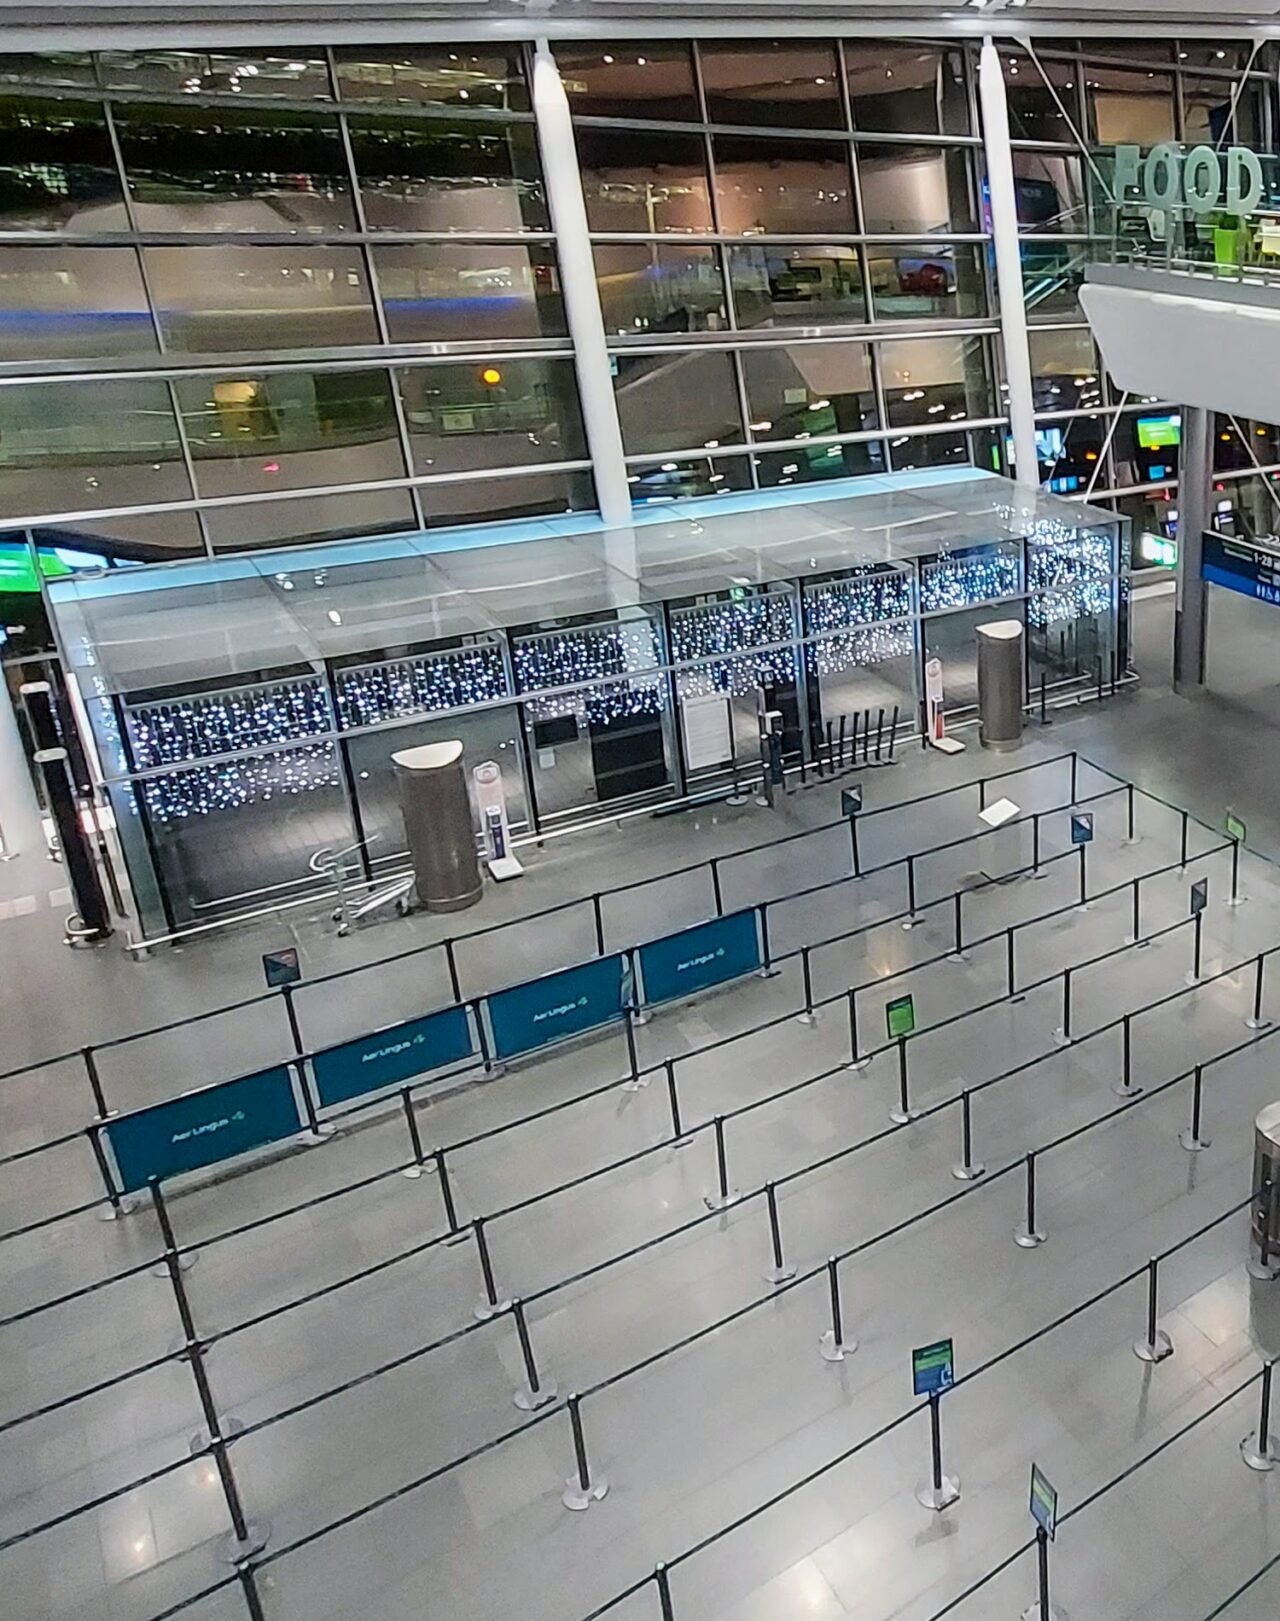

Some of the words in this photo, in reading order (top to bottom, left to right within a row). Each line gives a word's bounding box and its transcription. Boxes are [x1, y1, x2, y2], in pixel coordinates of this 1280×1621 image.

[1113, 144, 1263, 215] FOOD
[171, 1129, 192, 1144] Aer
[192, 1118, 230, 1137] Lingus
